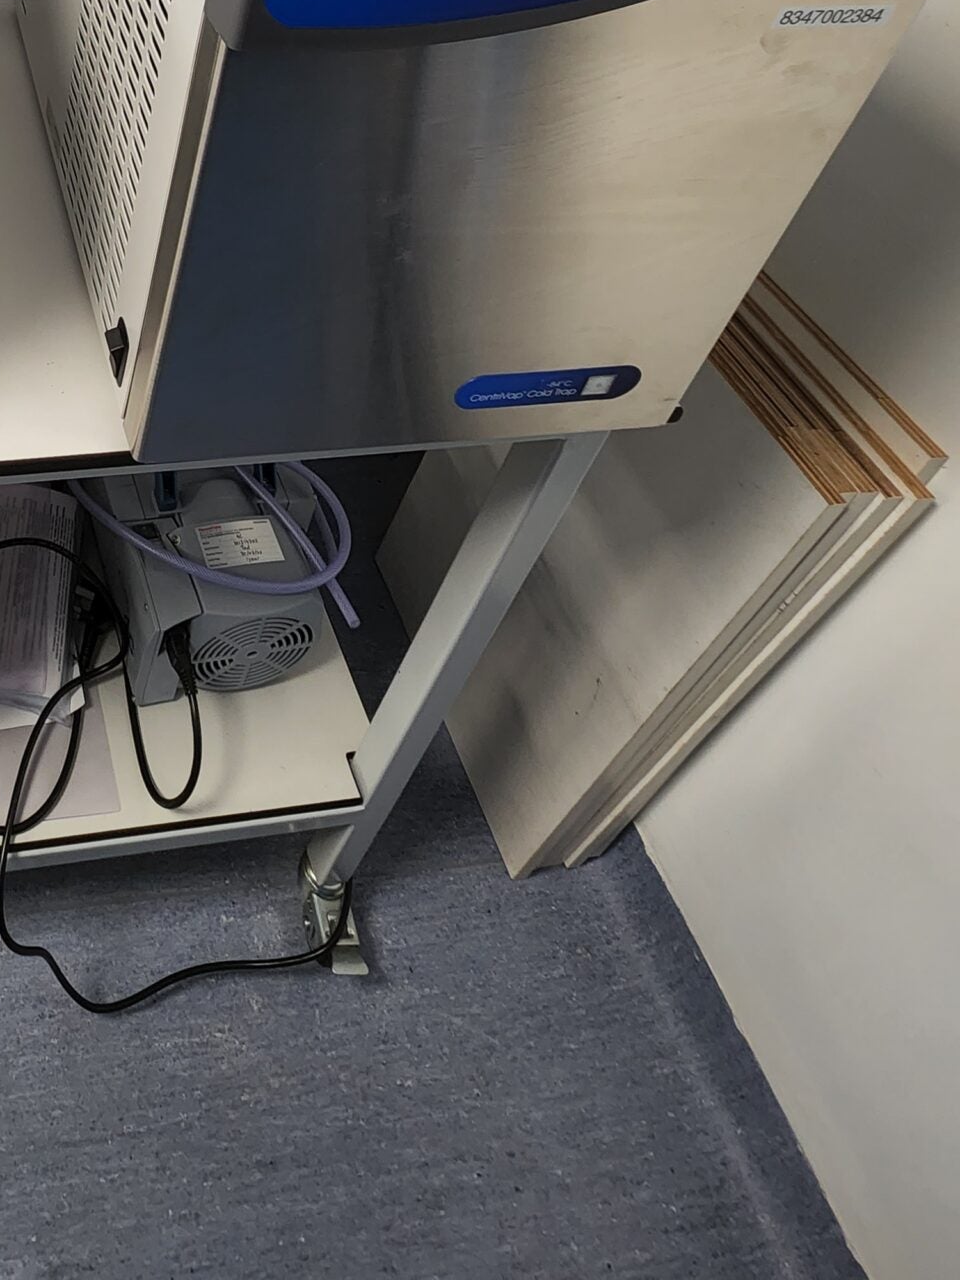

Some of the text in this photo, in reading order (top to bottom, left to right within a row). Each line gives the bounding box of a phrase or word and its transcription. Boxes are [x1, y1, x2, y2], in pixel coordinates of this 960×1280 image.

[779, 8, 885, 25] 8347002384
[526, 388, 552, 398] Cold
[554, 388, 577, 396] Trap
